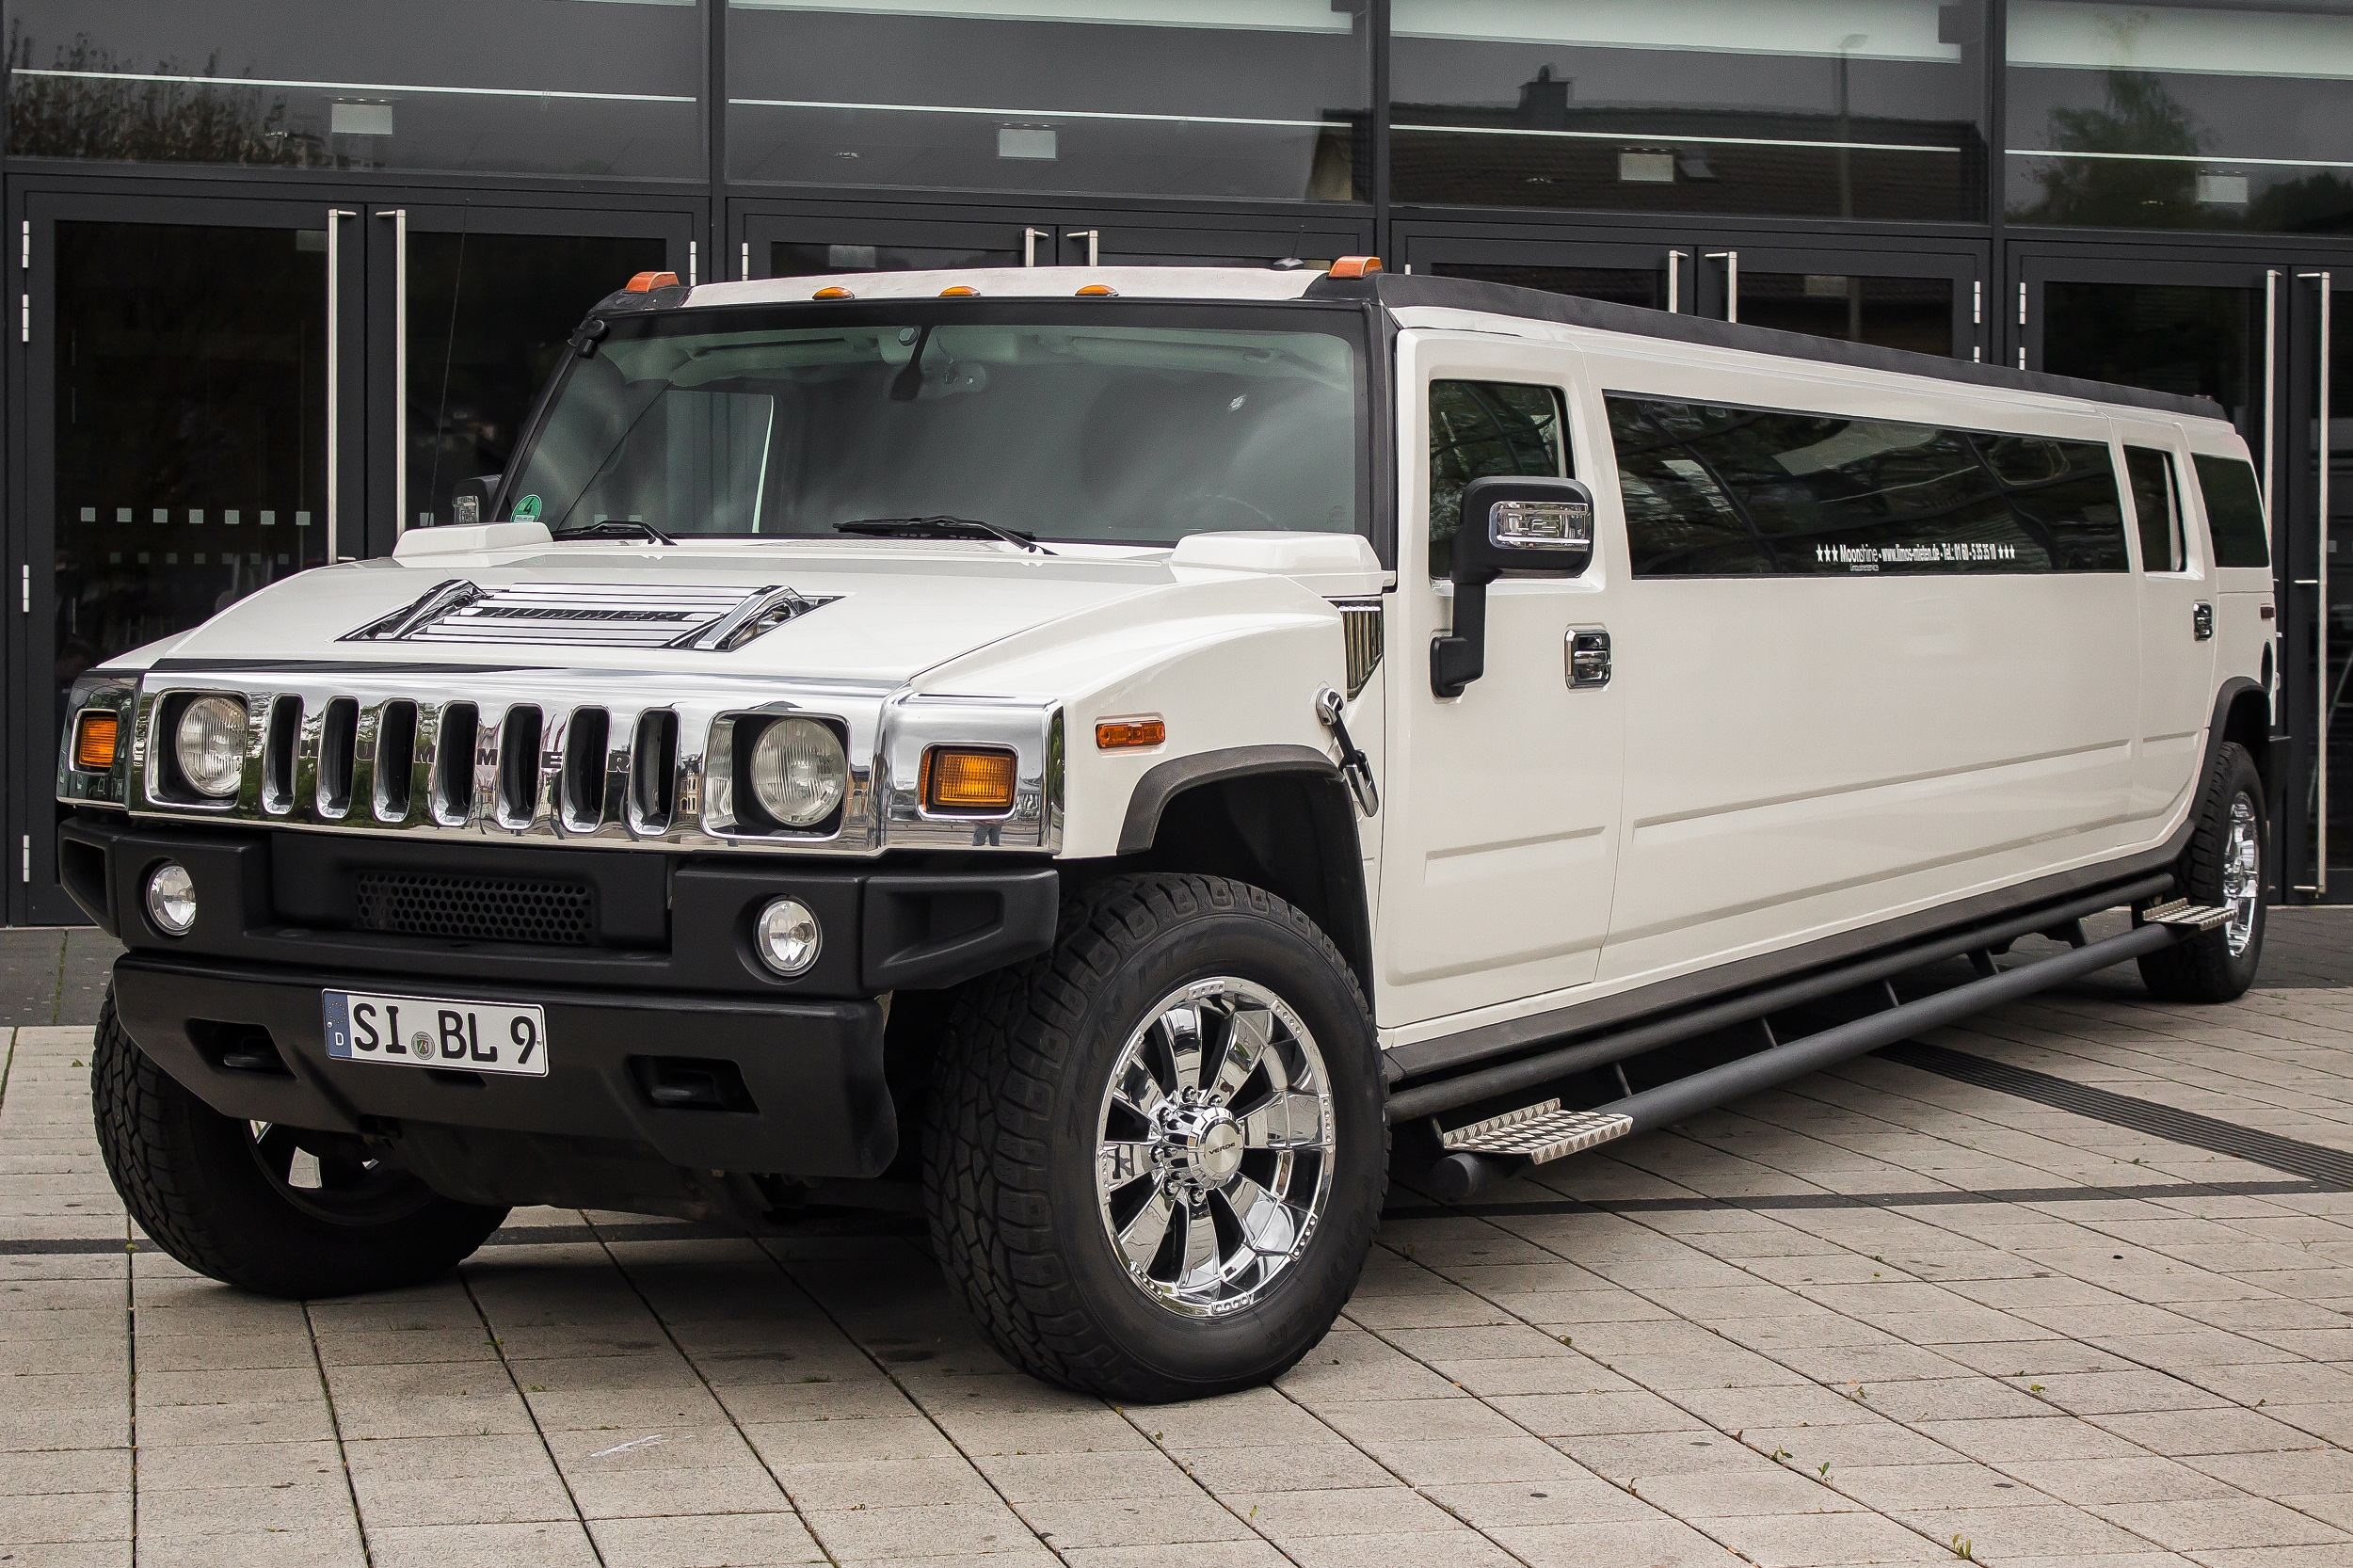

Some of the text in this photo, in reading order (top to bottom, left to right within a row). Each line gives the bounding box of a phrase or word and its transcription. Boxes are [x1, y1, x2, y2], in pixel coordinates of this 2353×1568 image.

[523, 498, 535, 514] 4
[1840, 544, 1879, 563] Moonshine
[471, 607, 682, 621] HUMMER
[299, 738, 632, 774] HUMMER
[335, 1032, 344, 1046] D
[353, 1003, 407, 1054] SI
[438, 1010, 498, 1062] BL
[510, 1016, 536, 1064] 9
[1209, 1142, 1236, 1155] VERDE
